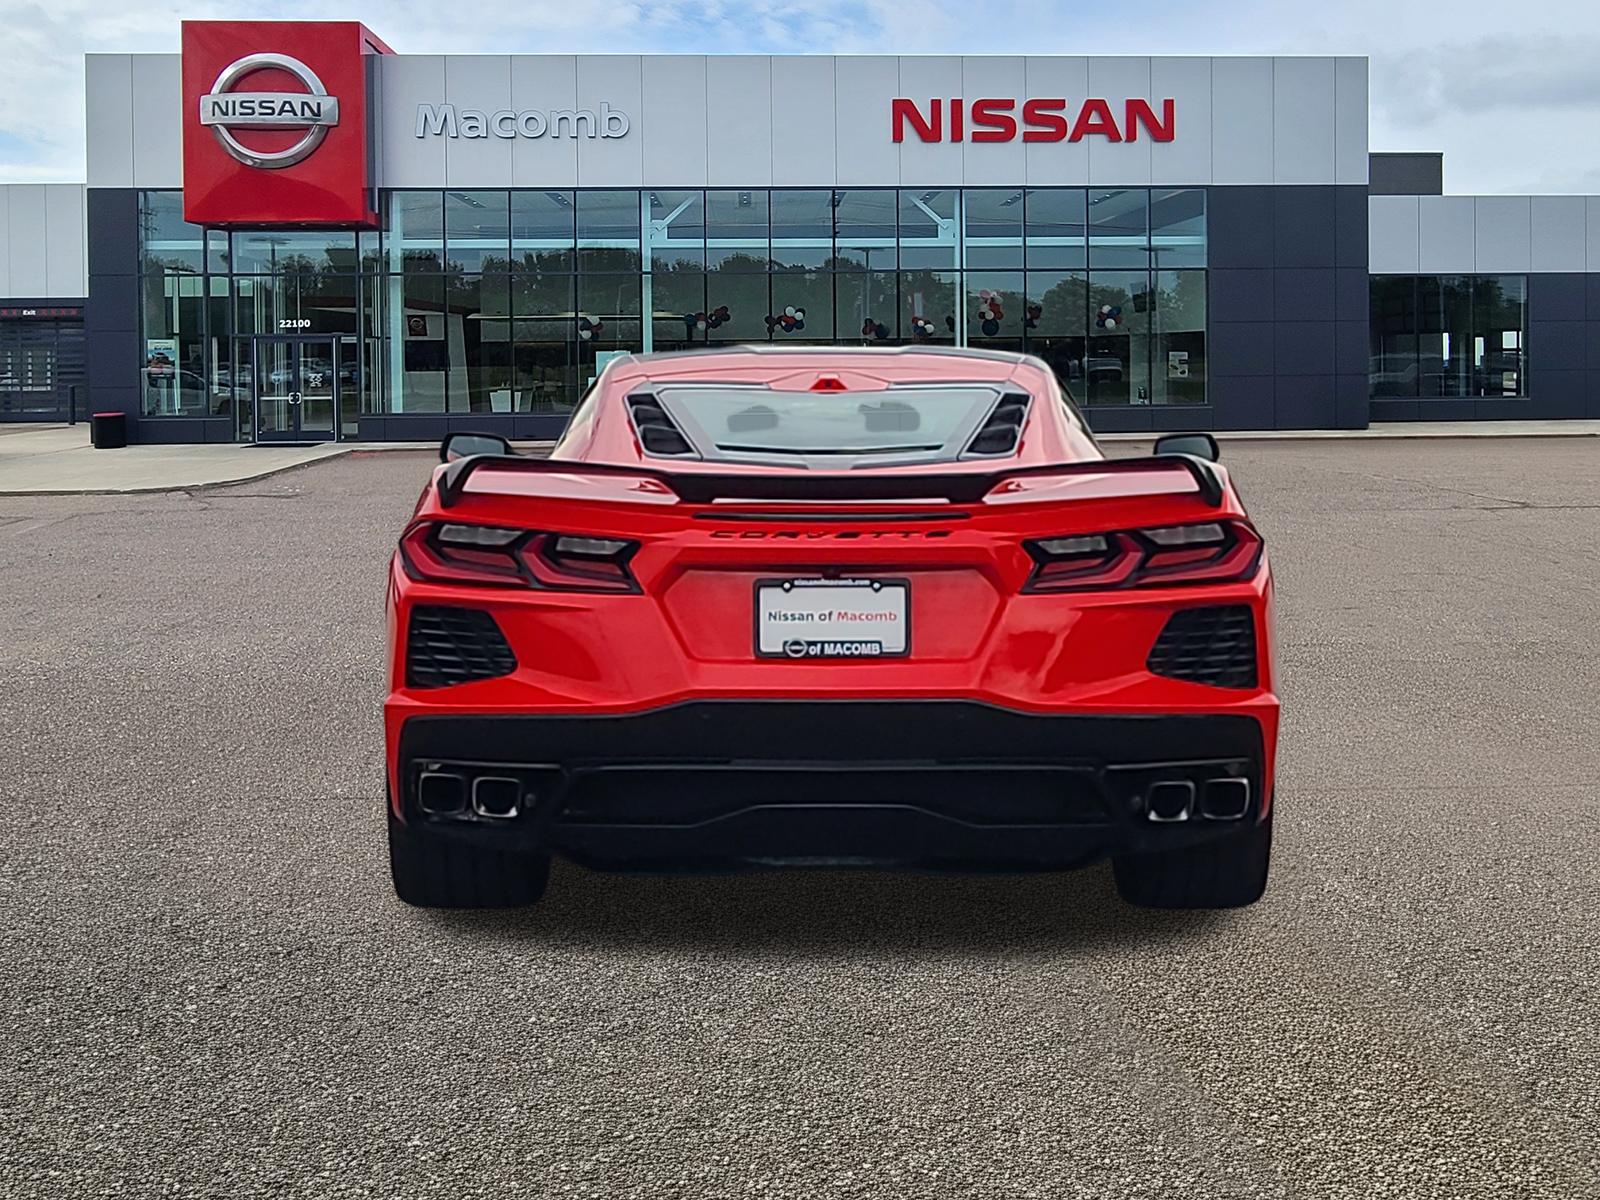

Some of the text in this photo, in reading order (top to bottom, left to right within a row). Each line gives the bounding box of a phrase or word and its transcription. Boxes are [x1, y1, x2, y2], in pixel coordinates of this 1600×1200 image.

[211, 100, 322, 118] NISSAN
[415, 102, 630, 138] Macomb
[891, 98, 1175, 143] NISSAN
[279, 319, 311, 328] 22100
[709, 530, 953, 539] CORVETTE
[768, 610, 898, 622] Nissan of Macomb
[808, 642, 881, 655] of MACOMB
